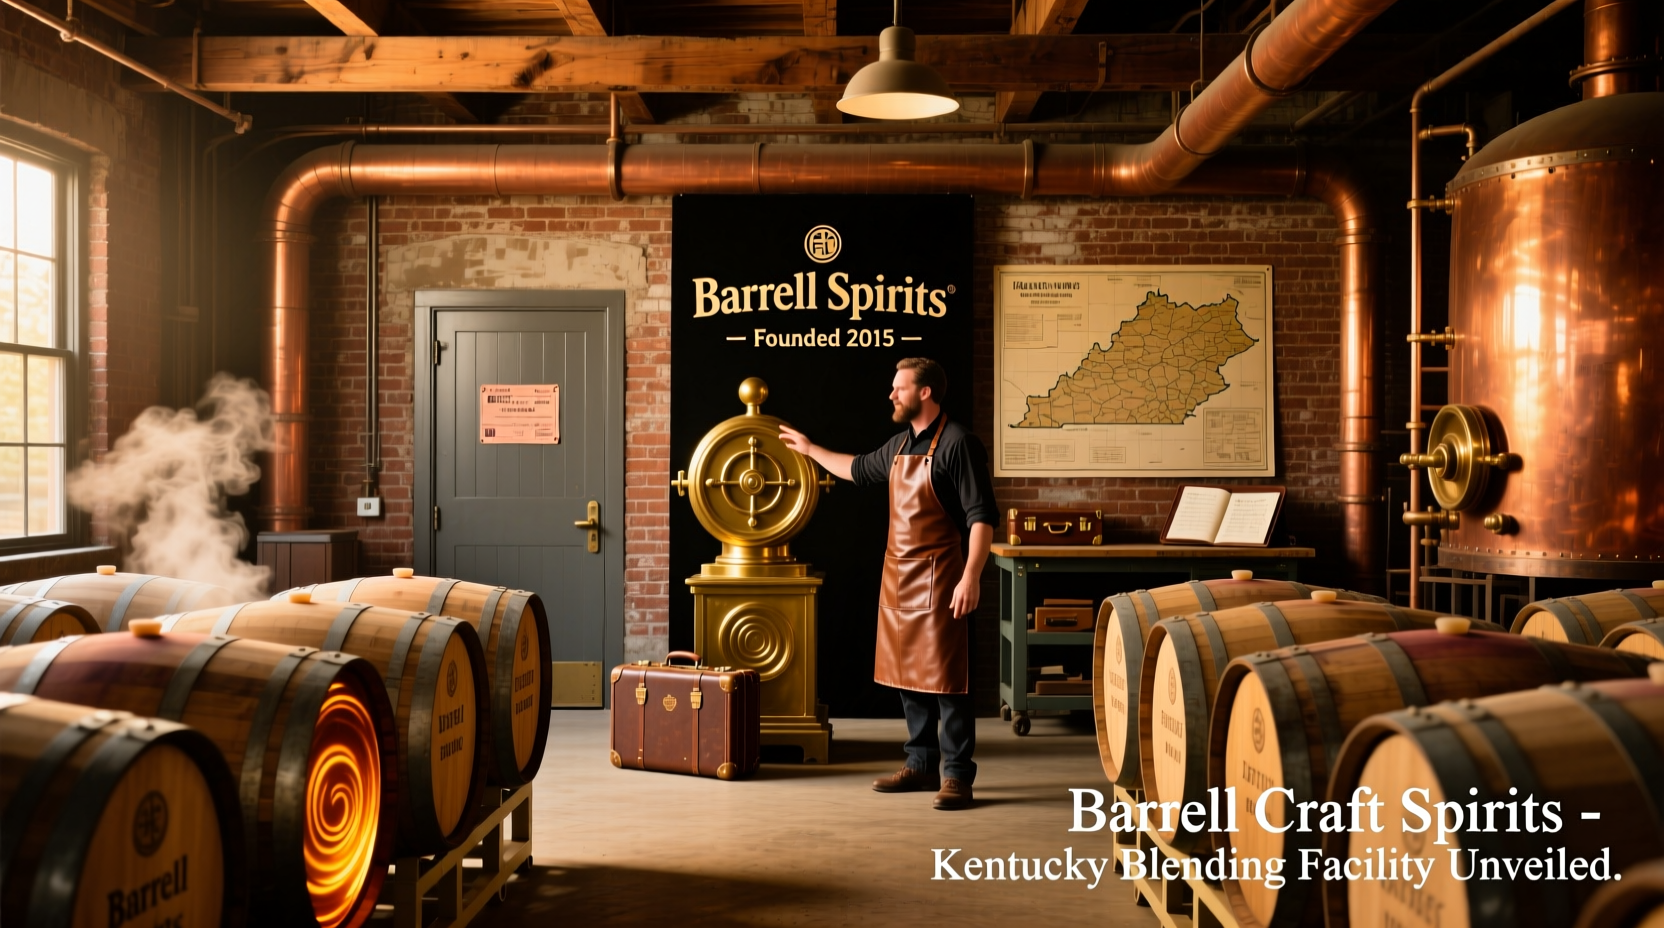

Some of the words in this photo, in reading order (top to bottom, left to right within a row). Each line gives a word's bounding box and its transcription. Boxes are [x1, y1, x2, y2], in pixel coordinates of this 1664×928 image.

[692, 271, 817, 318] Barrell
[754, 328, 840, 347] Founded
[846, 328, 895, 347] 2015
[107, 854, 188, 928] Barrell
